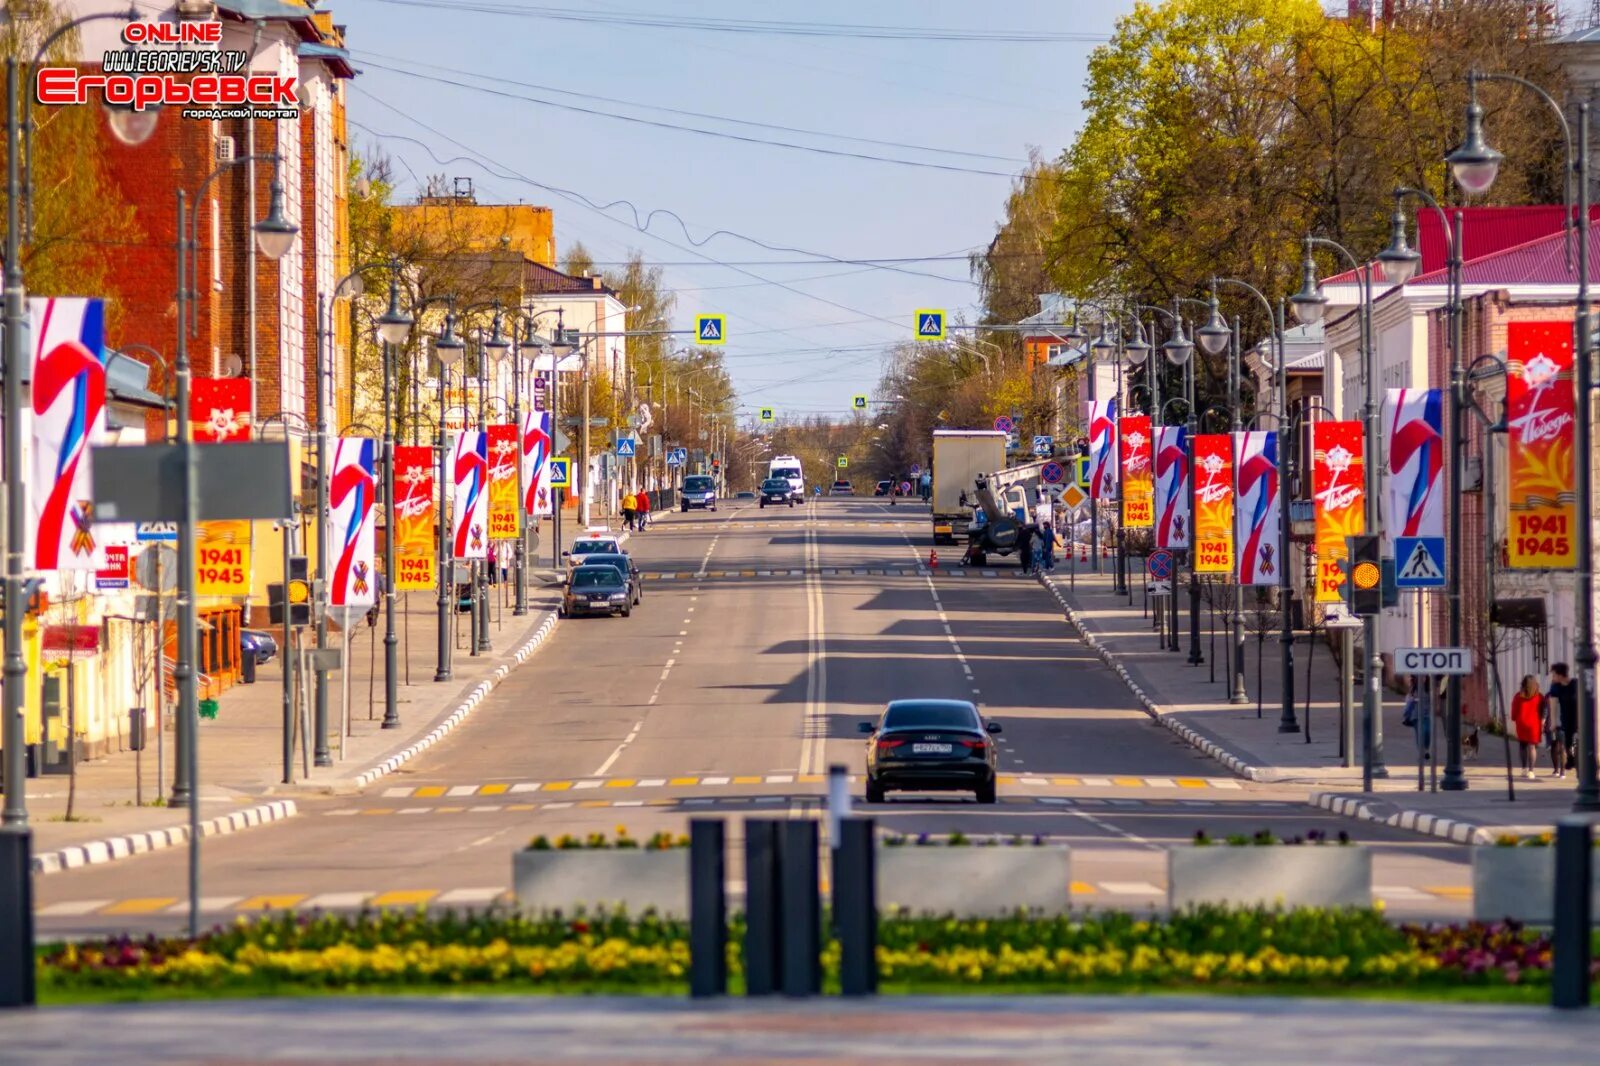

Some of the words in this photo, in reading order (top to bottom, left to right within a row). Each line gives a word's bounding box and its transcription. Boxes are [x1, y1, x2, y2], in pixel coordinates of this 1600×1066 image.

[1127, 502, 1149, 512] 1941
[492, 513, 515, 523] 1941
[1126, 513, 1150, 521] 1945
[491, 524, 516, 533] 1945
[1517, 515, 1567, 535] 1941
[1200, 542, 1228, 553] 1941
[1516, 537, 1570, 556] 1945
[200, 548, 242, 565] 1941
[1199, 554, 1229, 565] 1945
[400, 559, 429, 570] 1941
[1322, 562, 1341, 577] 19
[198, 568, 244, 584] 1945
[399, 571, 431, 583] 1945
[1321, 579, 1345, 593] 19
[1405, 652, 1462, 669] СТОП
